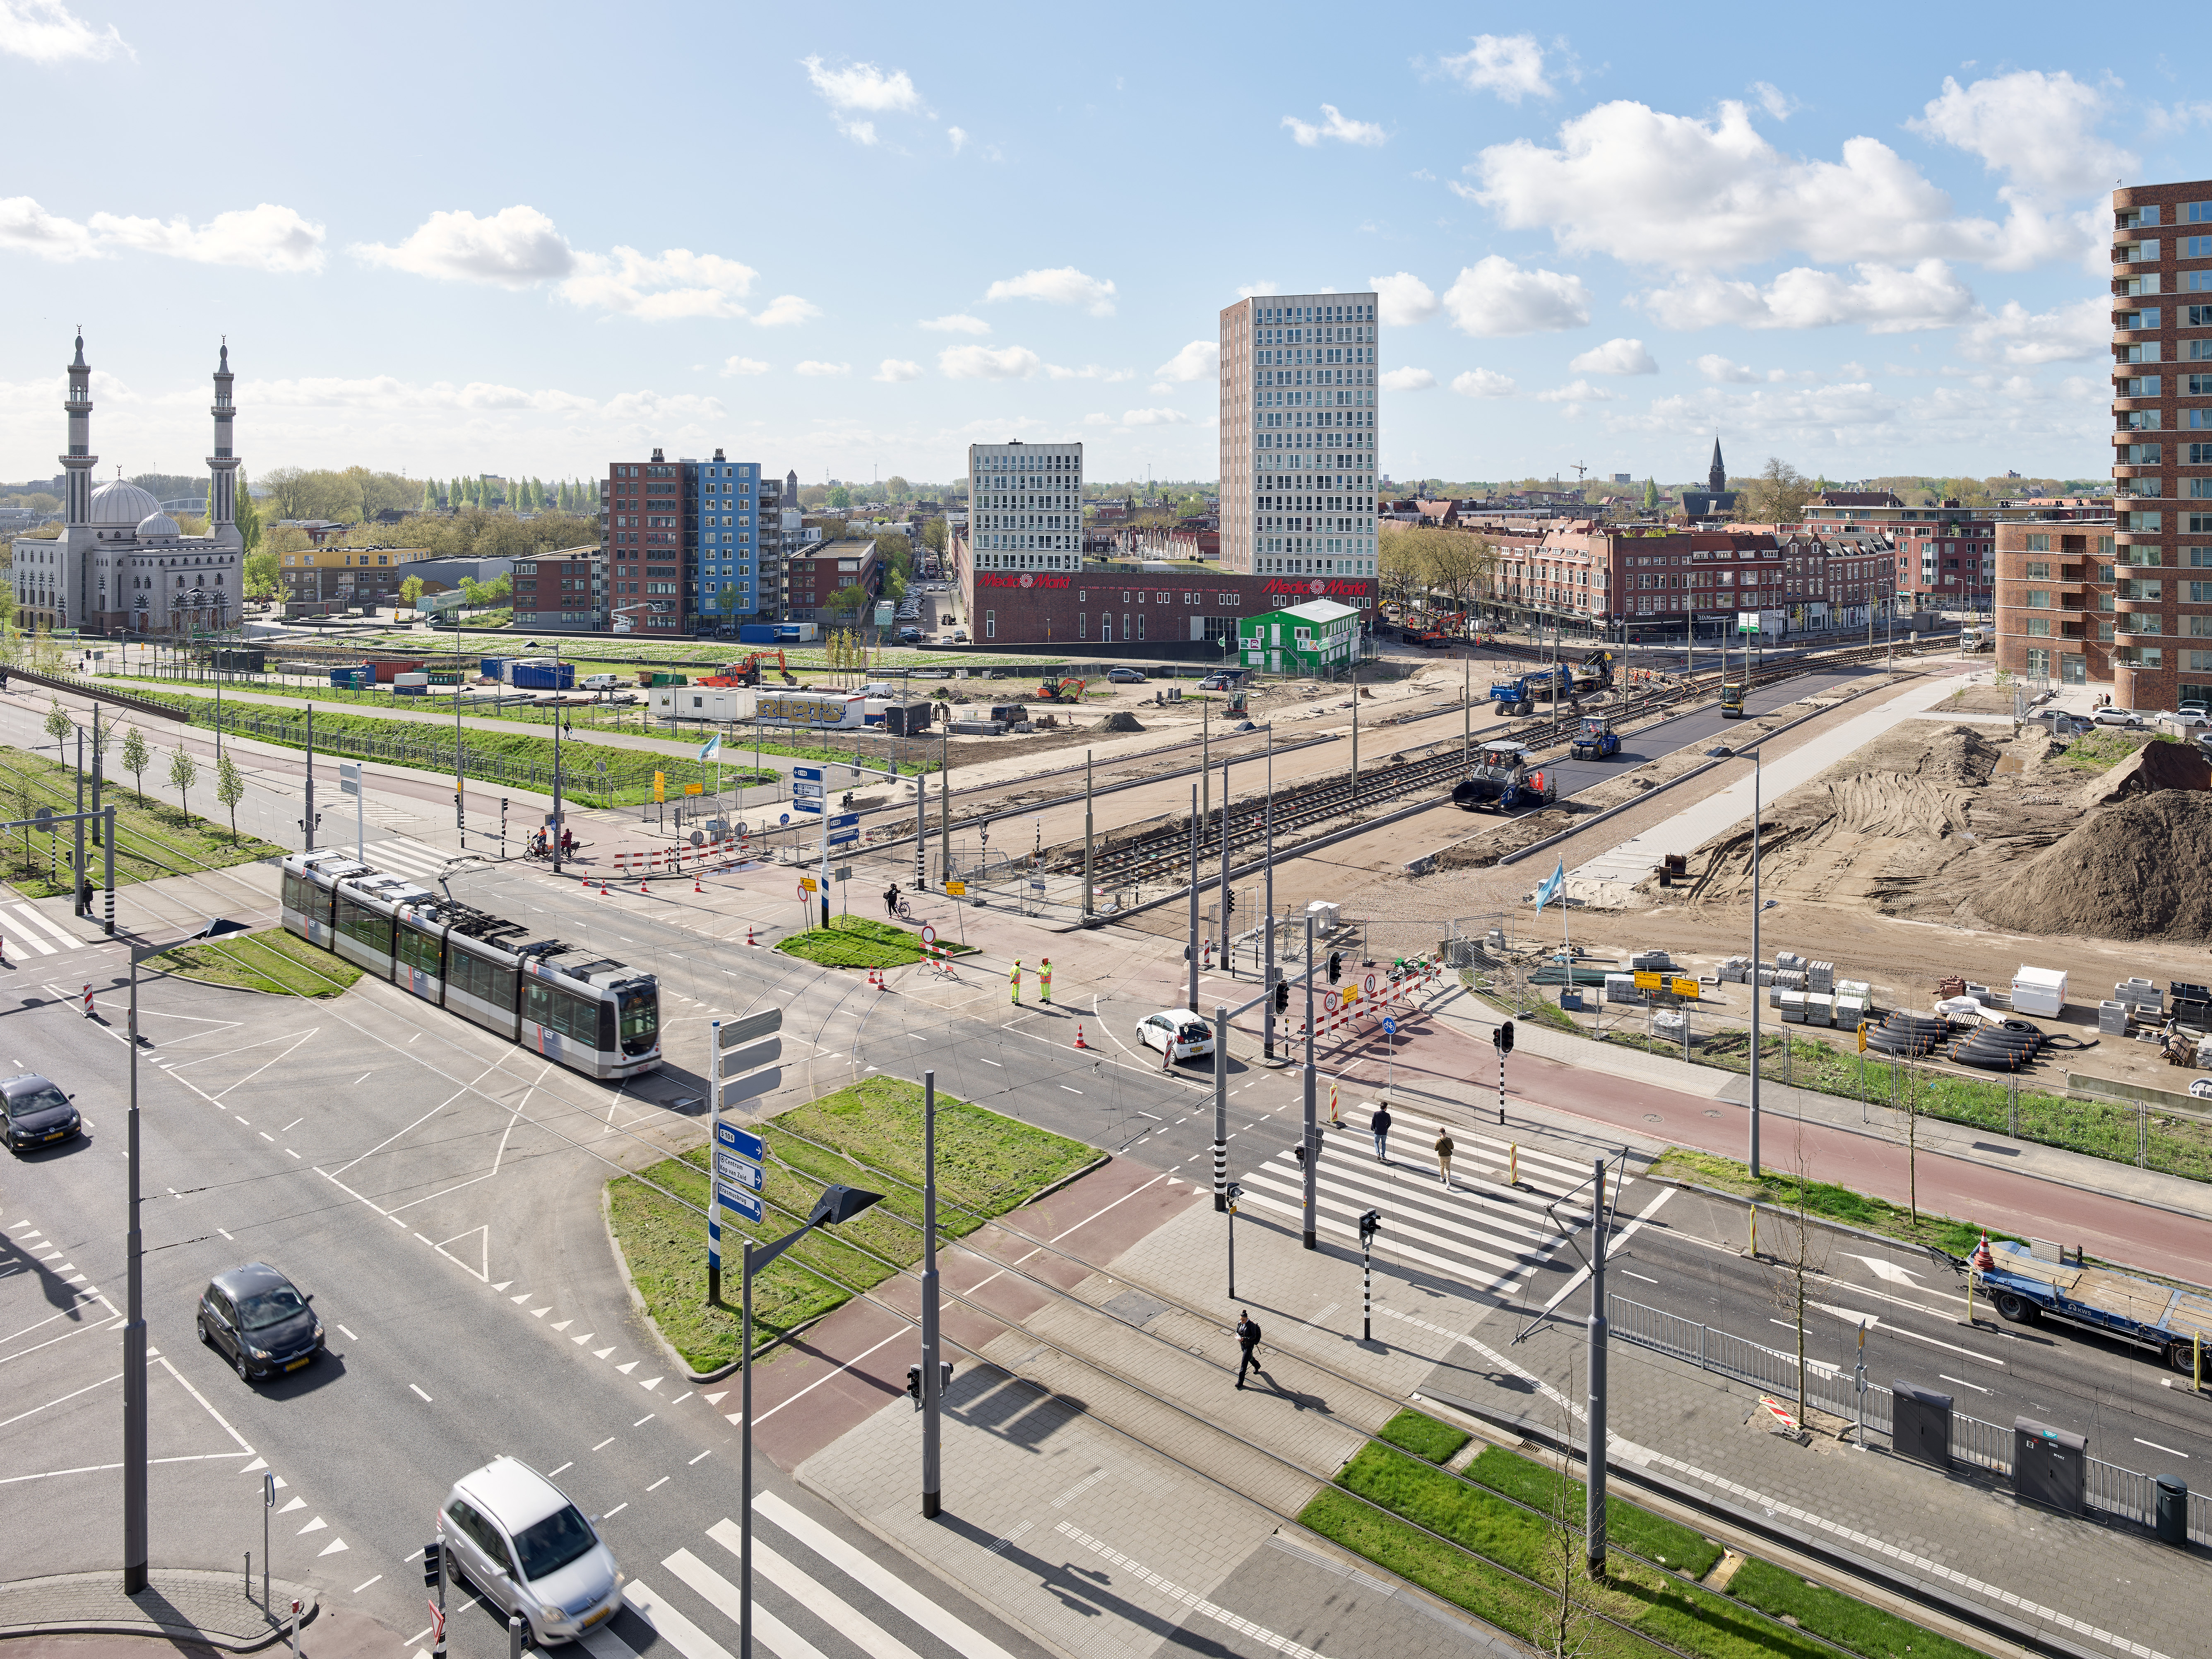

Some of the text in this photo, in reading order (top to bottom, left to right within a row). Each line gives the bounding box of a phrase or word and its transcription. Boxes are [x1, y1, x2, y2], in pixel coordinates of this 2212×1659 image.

[977, 573, 1071, 588] Media Markt
[1262, 578, 1368, 595] Media Markt
[725, 1132, 733, 1141] 106
[725, 1158, 743, 1170] Centrum
[737, 1172, 746, 1181] Zuid
[720, 1186, 746, 1205] Erasmusbrug
[2077, 1307, 2092, 1316] KWS
